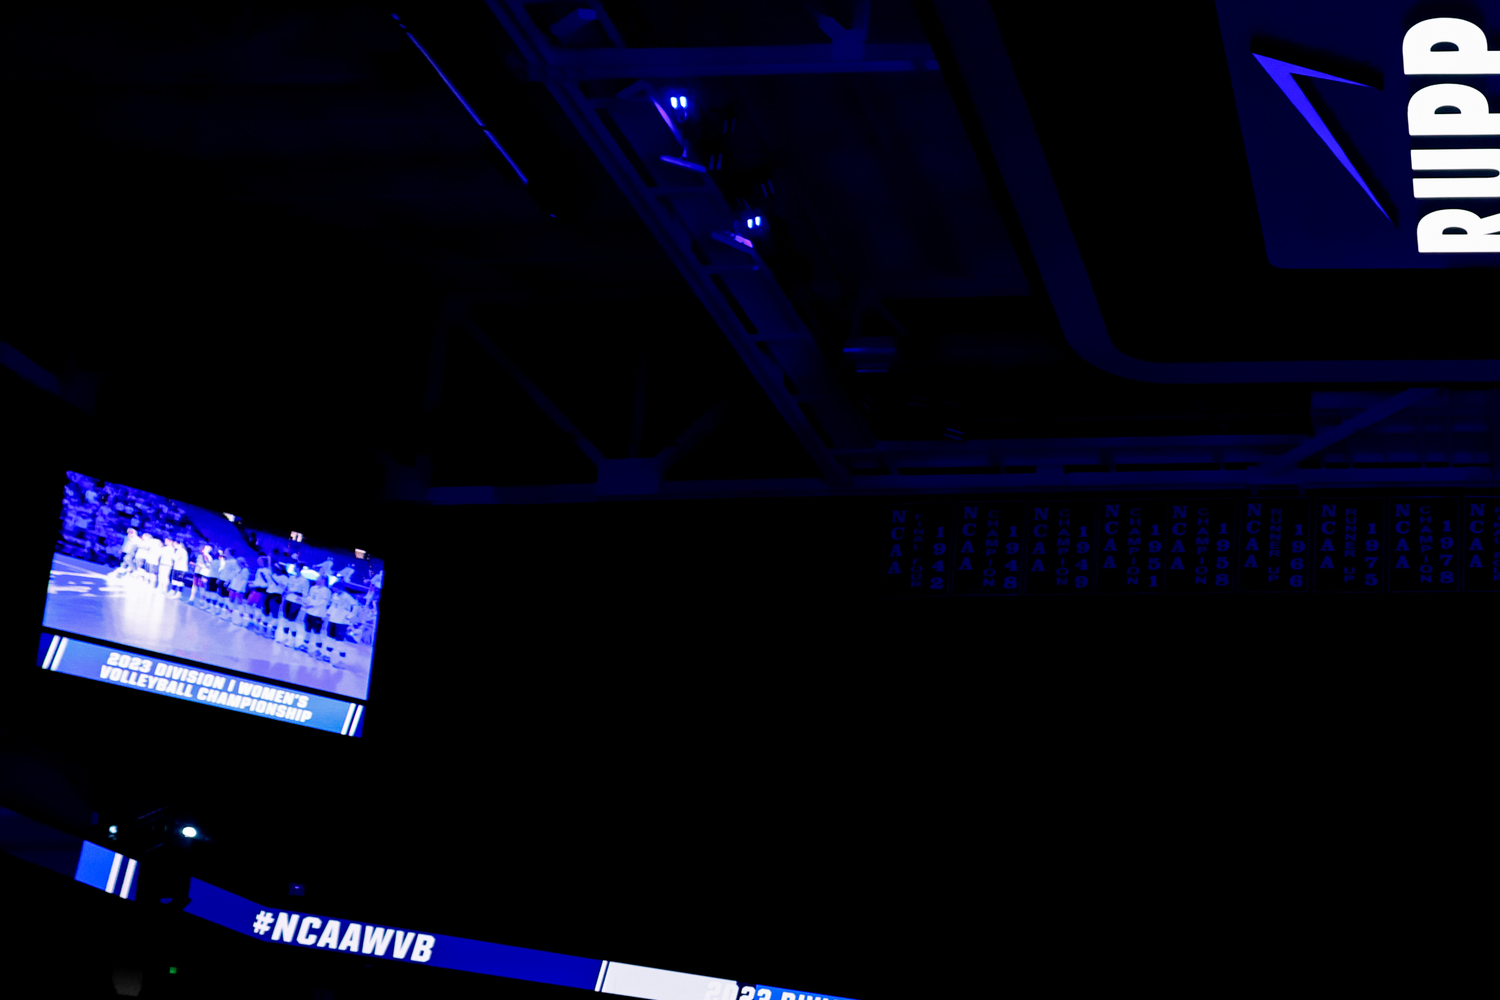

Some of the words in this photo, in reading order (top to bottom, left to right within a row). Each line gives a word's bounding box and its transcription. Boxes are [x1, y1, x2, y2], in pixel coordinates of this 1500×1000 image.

[887, 510, 906, 574] NCAA
[913, 513, 924, 550] FINAL
[930, 526, 946, 589] 1942
[958, 506, 978, 570] NCAA
[983, 510, 998, 586] CHAMPION
[1003, 526, 1019, 589] 1948
[1031, 508, 1049, 572] NCAA
[1056, 509, 1070, 585] CHAMPION
[1075, 526, 1090, 588] 1949
[1102, 504, 1120, 568] NCAA
[1127, 508, 1141, 584] CHAMPION
[1148, 524, 1162, 587] 1951
[1170, 506, 1188, 570] NCAA
[1195, 508, 1209, 584] CHAMPION
[1215, 523, 1230, 586] 1958
[1244, 504, 1262, 568] NCAA
[1268, 508, 1282, 558] RUNNER
[1289, 524, 1305, 587] 1966
[1319, 504, 1336, 568] NCAA
[1344, 508, 1357, 557] RUNNER
[1364, 523, 1379, 586] 1975
[1395, 504, 1410, 568] NCAA
[1419, 506, 1433, 582] CHAMPION
[1439, 520, 1454, 584] 1978
[1469, 504, 1485, 568] NCAA
[911, 558, 923, 588] FOUR
[1268, 566, 1280, 582] UP
[1344, 567, 1355, 582] UP
[100, 664, 193, 698] VOLLEYBALL
[196, 688, 312, 722] CHAMPIONSHIP
[107, 652, 153, 673] 2023
[154, 662, 226, 691] DIVISION
[227, 679, 236, 693] I
[237, 681, 309, 708] WOMEN'S
[253, 910, 436, 962] #NCAAWVB
